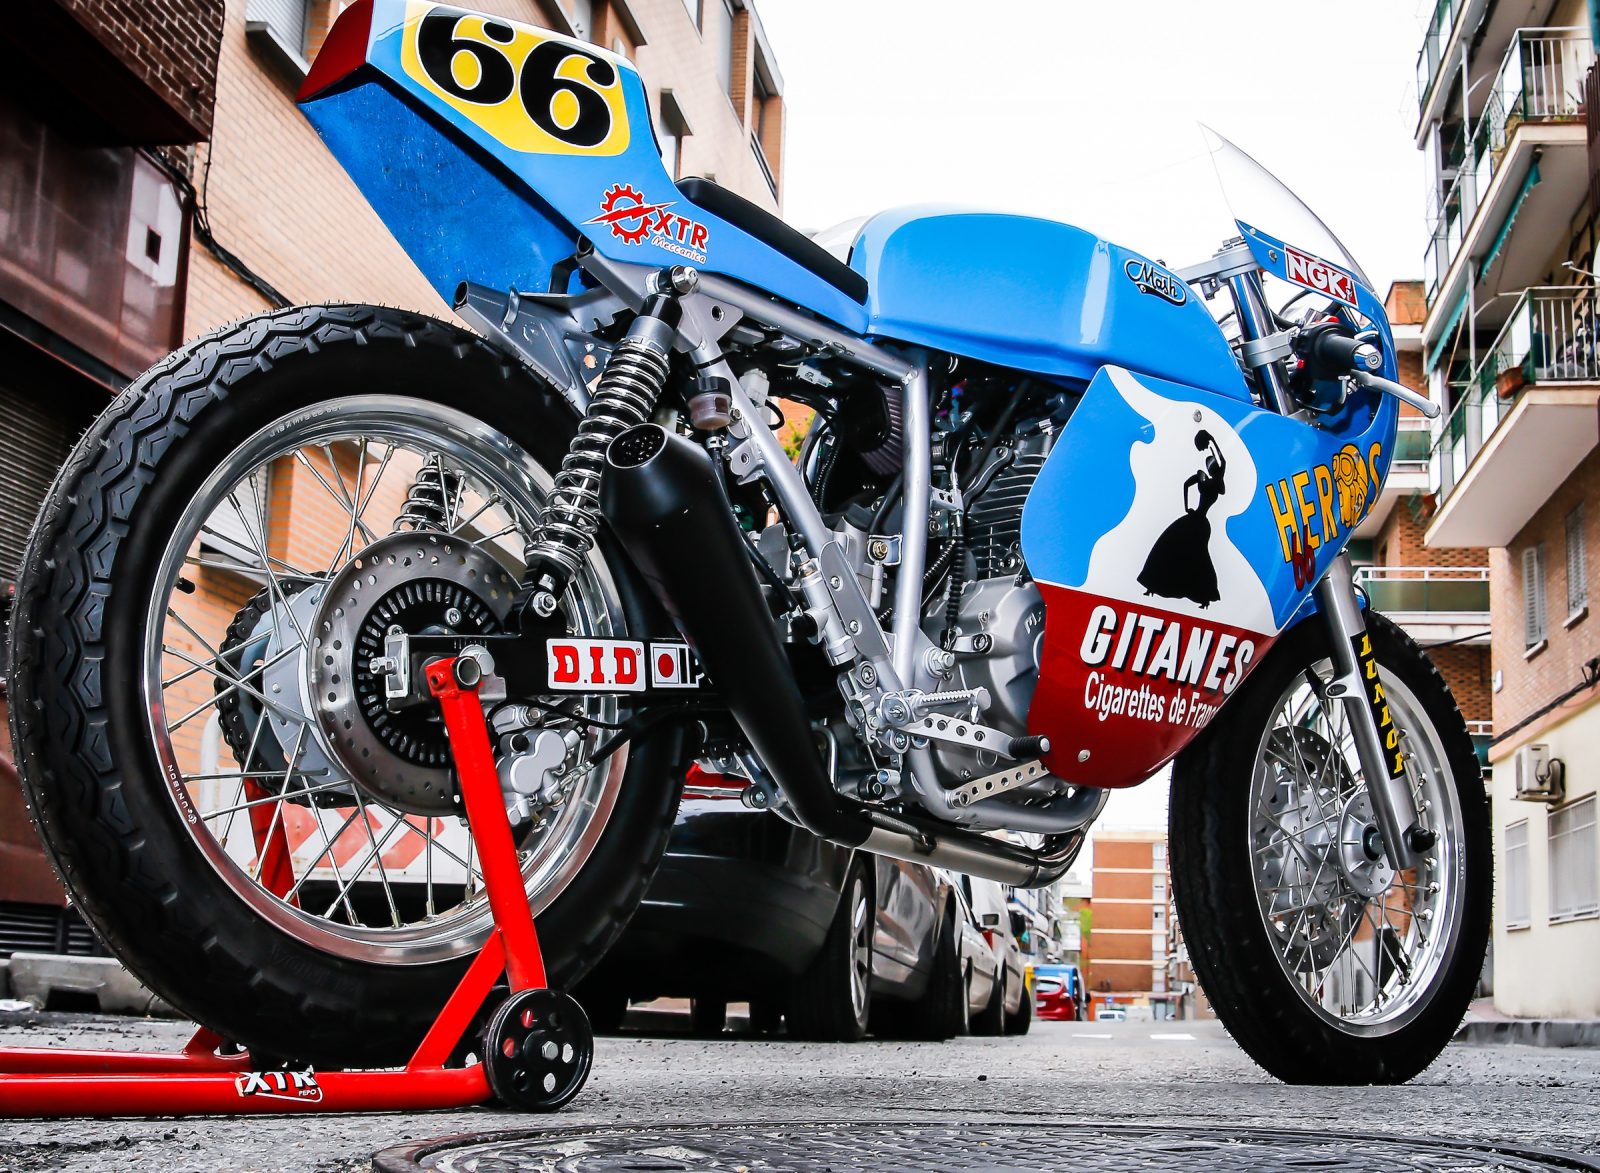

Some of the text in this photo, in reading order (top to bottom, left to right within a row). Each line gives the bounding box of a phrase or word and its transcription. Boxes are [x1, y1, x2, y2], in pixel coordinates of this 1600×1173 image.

[416, 5, 616, 147] 66
[651, 207, 708, 253] XTR
[652, 236, 706, 264] Meccanica
[1124, 259, 1180, 298] Mash
[1288, 251, 1347, 300] NGK
[1291, 524, 1316, 592] 66
[1080, 605, 1255, 695] GITANES
[1084, 671, 1165, 721] Cigarettes
[1168, 687, 1187, 726] de
[239, 1071, 317, 1093] XTR
[298, 1088, 317, 1097] PEPO
